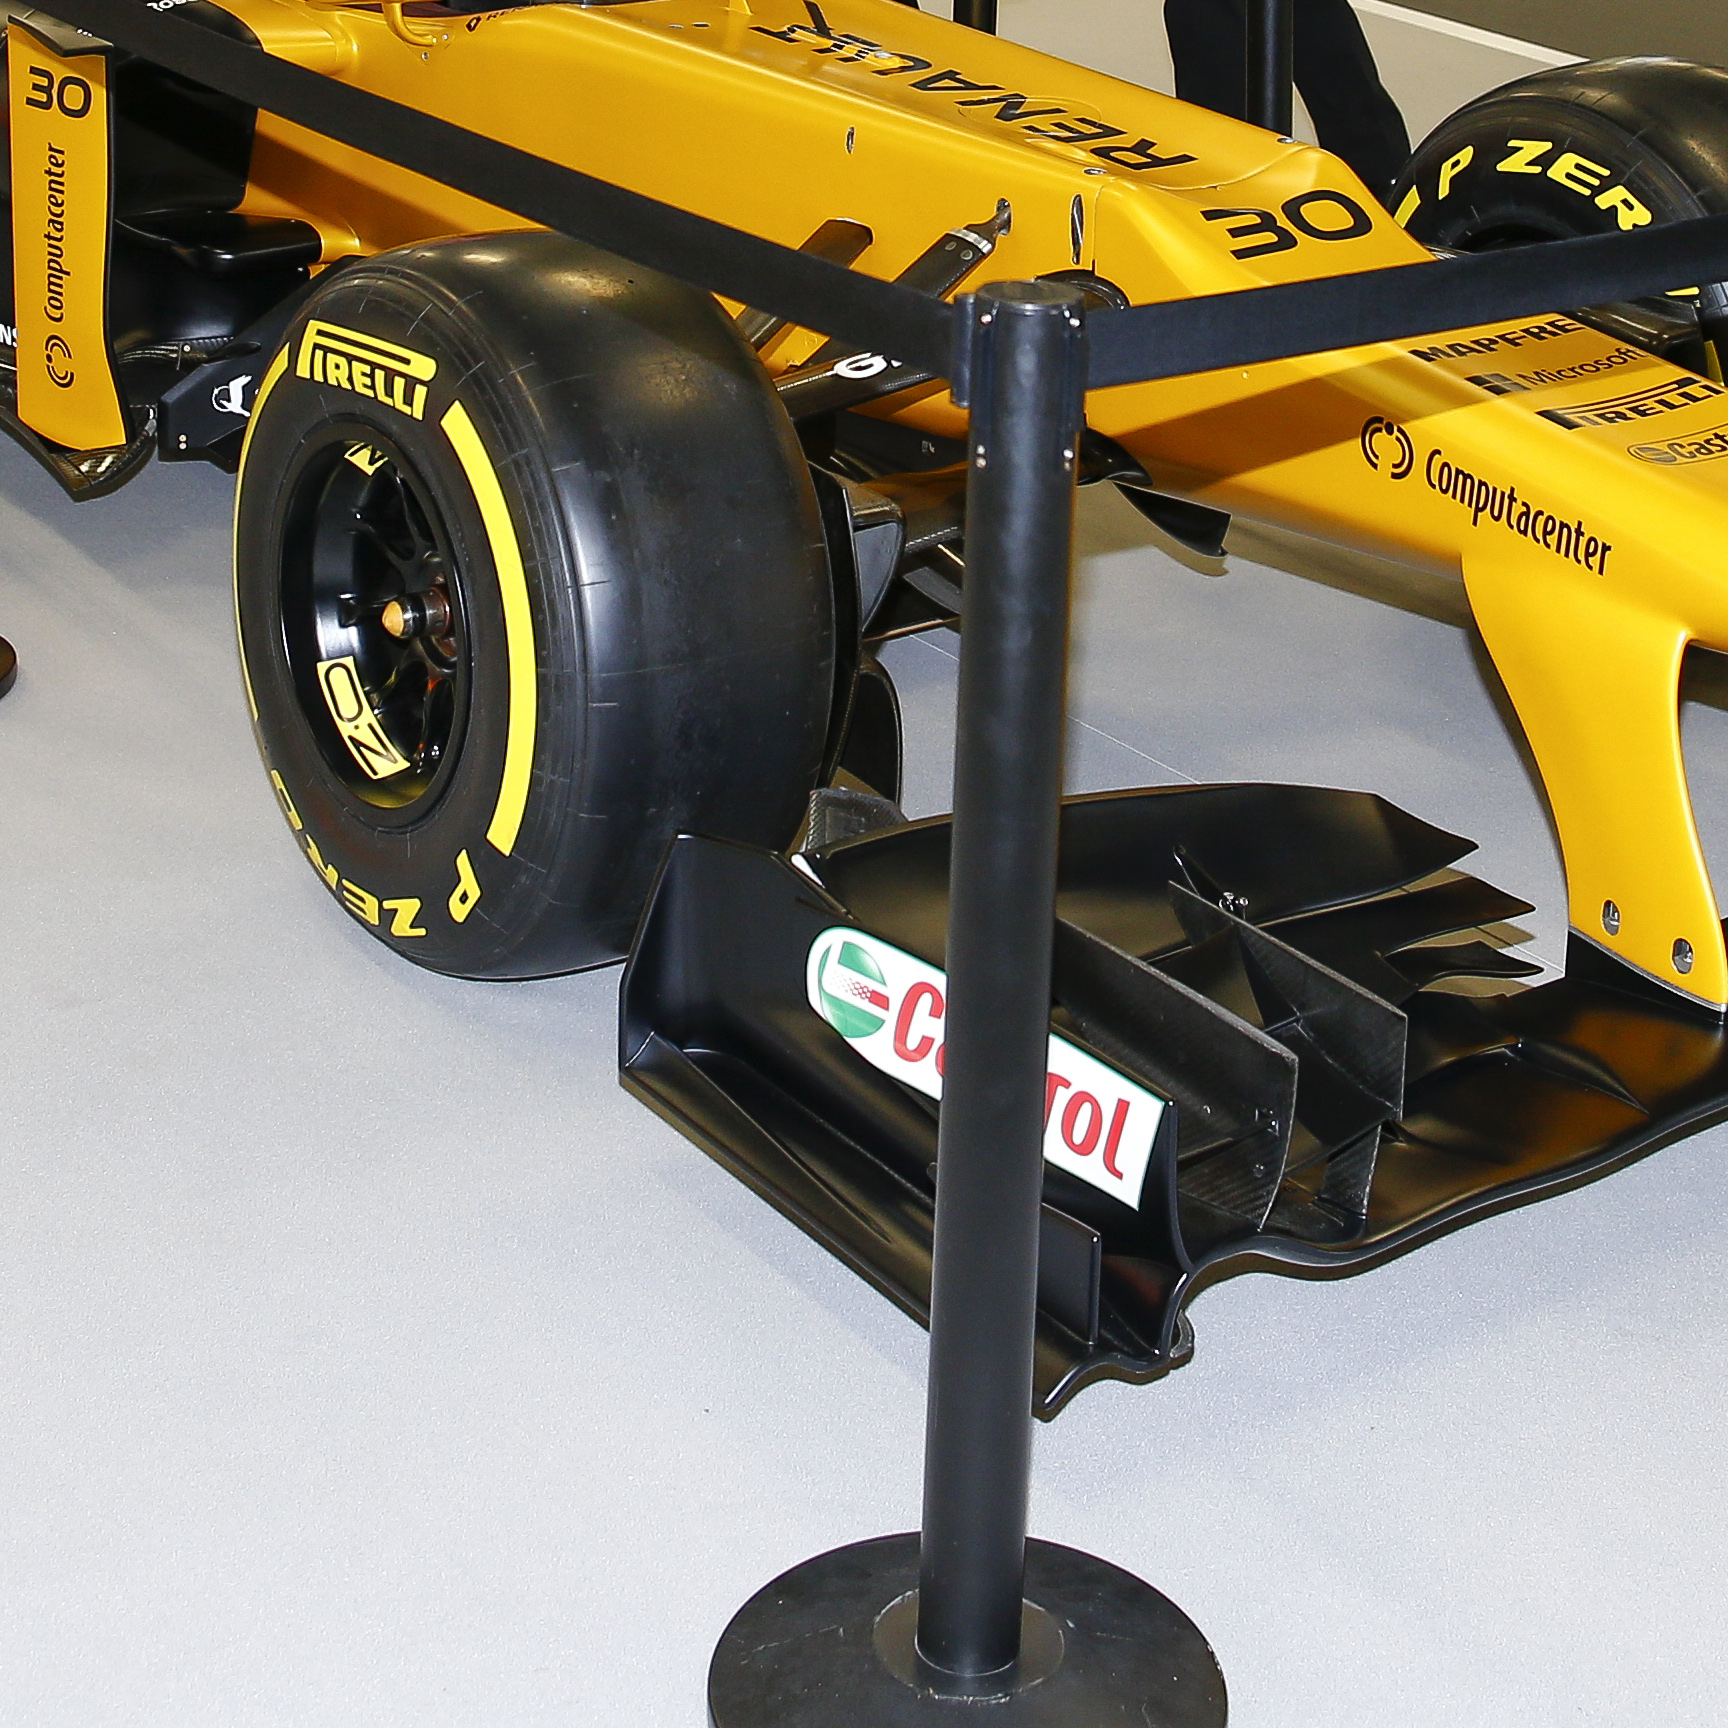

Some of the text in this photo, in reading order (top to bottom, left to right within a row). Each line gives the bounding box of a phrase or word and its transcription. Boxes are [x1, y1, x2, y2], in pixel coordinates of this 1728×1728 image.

[26, 65, 92, 118] 30
[44, 142, 71, 323] Computacenter
[1200, 189, 1373, 261] 30
[1439, 139, 1672, 257] P ZER
[296, 319, 438, 421] PIRELLI
[1408, 317, 1585, 363] MAPFRE
[1522, 346, 1648, 387] Microsoft
[1536, 377, 1727, 430] PIRELLI
[1425, 448, 1612, 577] Computacenter
[271, 769, 482, 937] P ZERO
